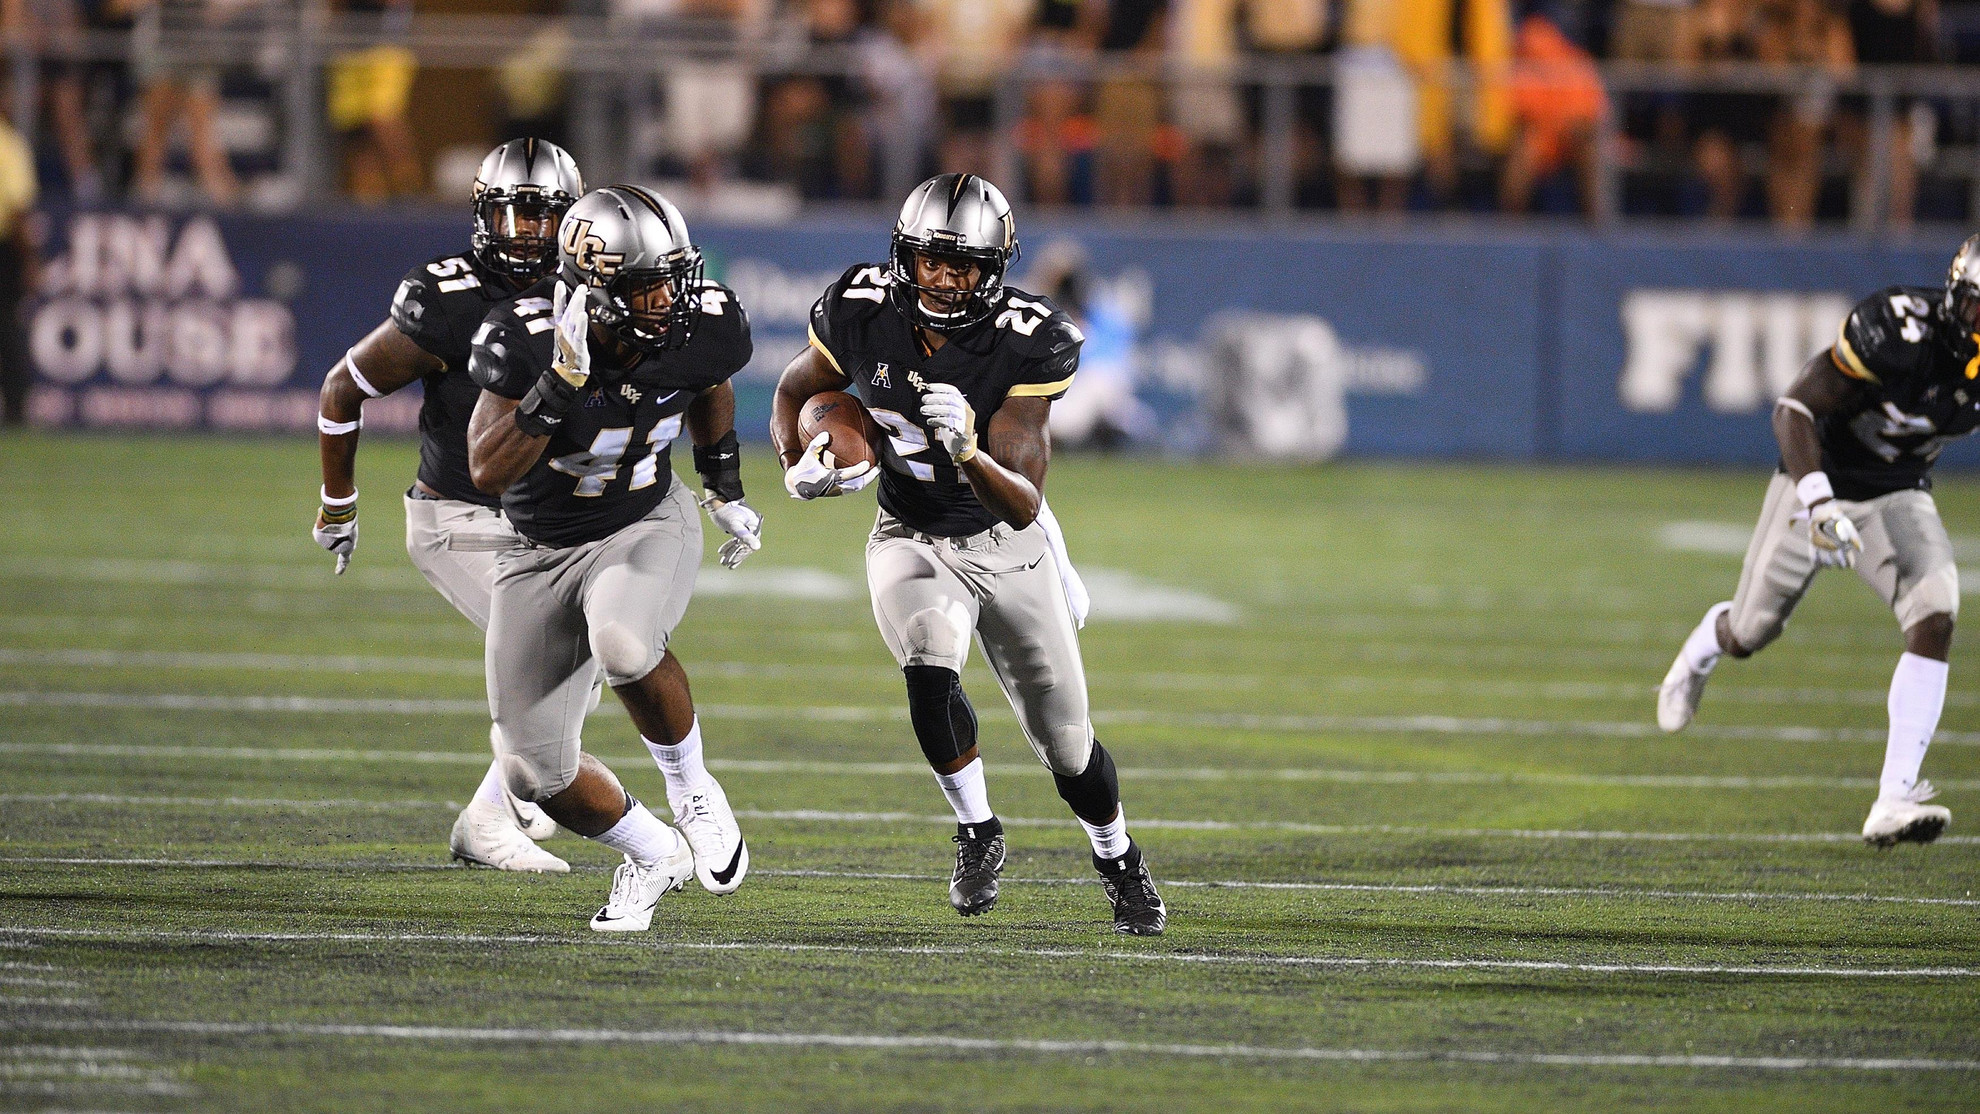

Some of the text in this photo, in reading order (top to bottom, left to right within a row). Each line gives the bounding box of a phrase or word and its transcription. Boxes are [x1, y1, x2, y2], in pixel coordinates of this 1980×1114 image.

[562, 217, 625, 287] UCF
[842, 266, 900, 304] 21
[994, 296, 1052, 336] 21
[620, 384, 642, 404] UCF
[907, 370, 928, 393] UCF
[548, 411, 684, 497] 41
[866, 407, 972, 484] 2
